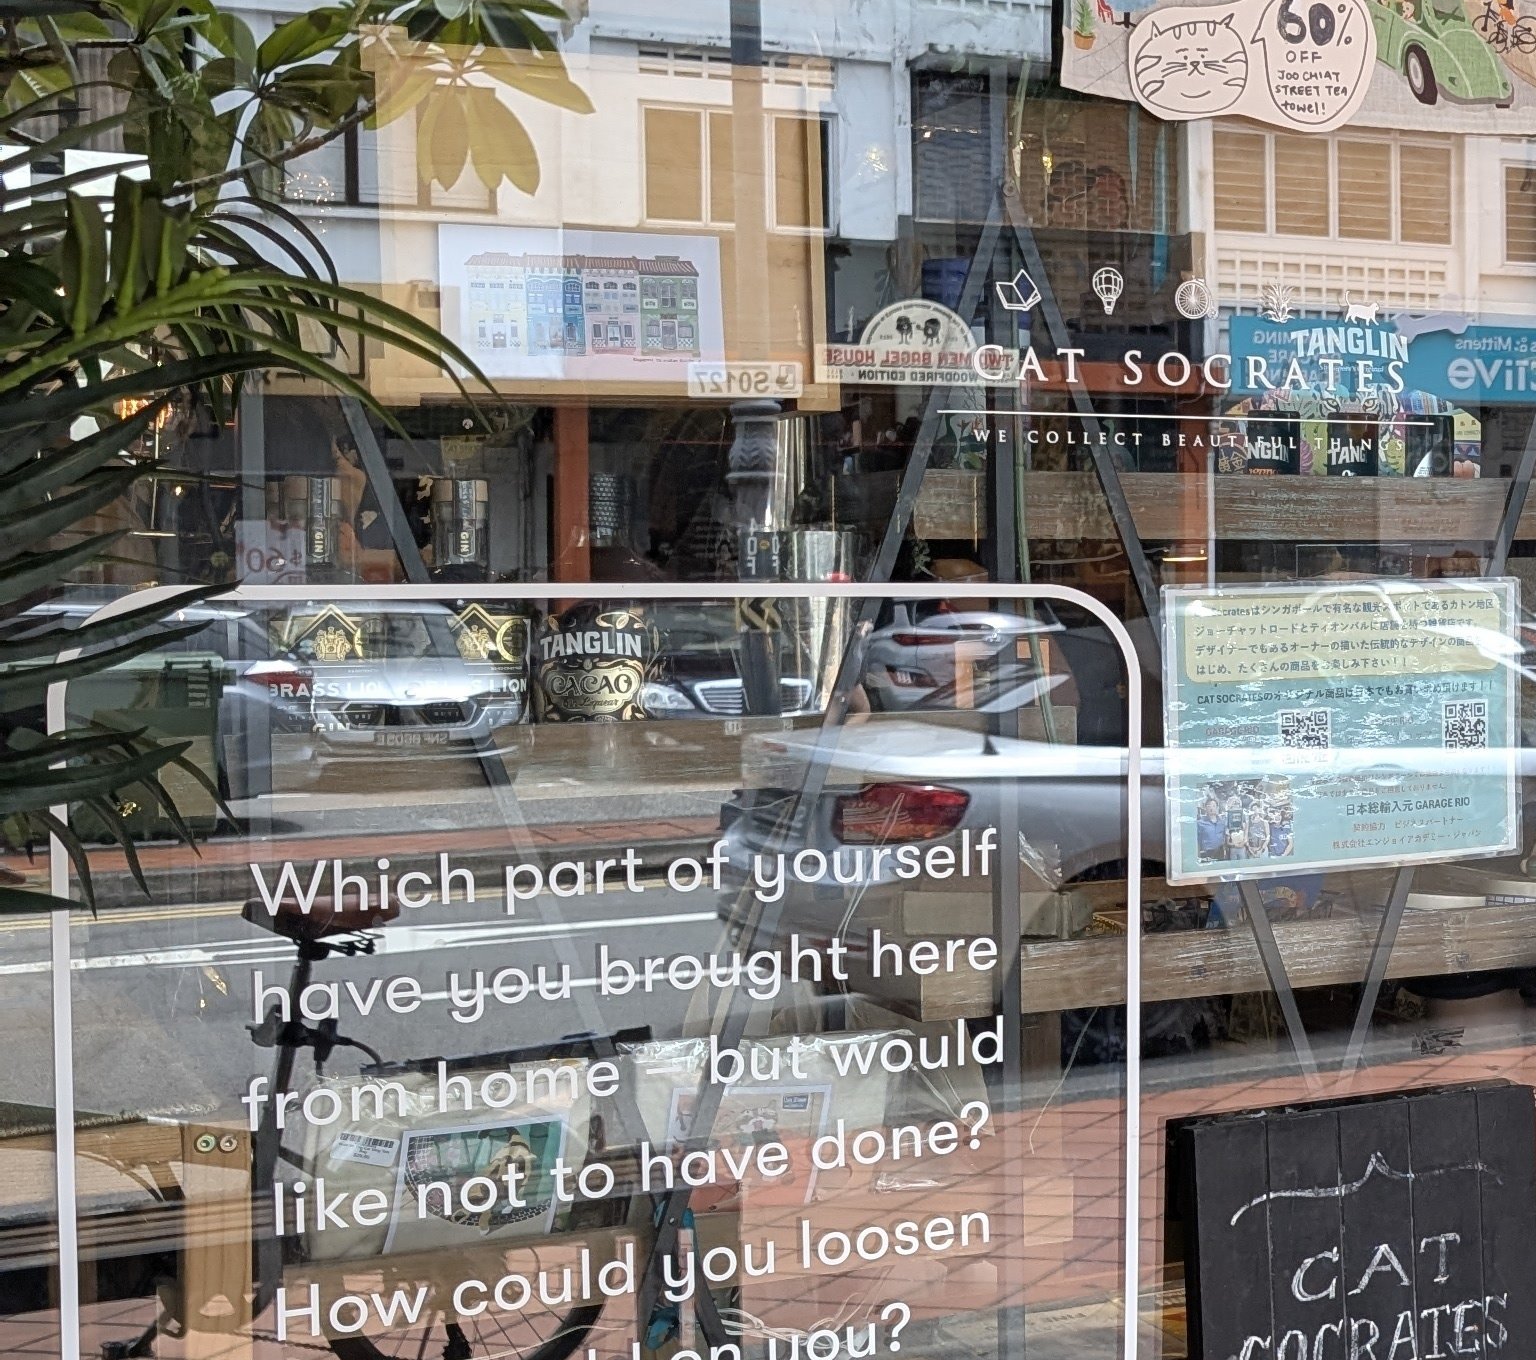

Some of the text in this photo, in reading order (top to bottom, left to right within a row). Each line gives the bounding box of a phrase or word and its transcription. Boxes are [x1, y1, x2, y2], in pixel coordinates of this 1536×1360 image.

[1285, 50, 1323, 64] OFF
[1277, 70, 1341, 82] JOO CHIAT
[1275, 85, 1348, 97] STREET TEA
[1280, 99, 1326, 116] towel!
[1290, 326, 1410, 364] TANGLIN
[972, 343, 1085, 383] CAT
[1123, 349, 1405, 395] SOCRATES
[973, 429, 1404, 453] WE COLLECT BEAUTIFUL THINGS
[314, 530, 325, 554] GIN
[459, 531, 471, 554] GIN
[540, 631, 642, 660] TANGLIN
[551, 674, 633, 696] CACAO
[1415, 798, 1453, 811] GARAGE
[1454, 796, 1470, 807] RIO
[250, 827, 998, 917] Which part of yourself
[254, 929, 999, 1025] have you brought here
[241, 1014, 1005, 1132] from home but would
[274, 1100, 990, 1237] like not to have done?
[275, 1210, 991, 1342] How could you loosen
[1289, 1232, 1461, 1302] CAT
